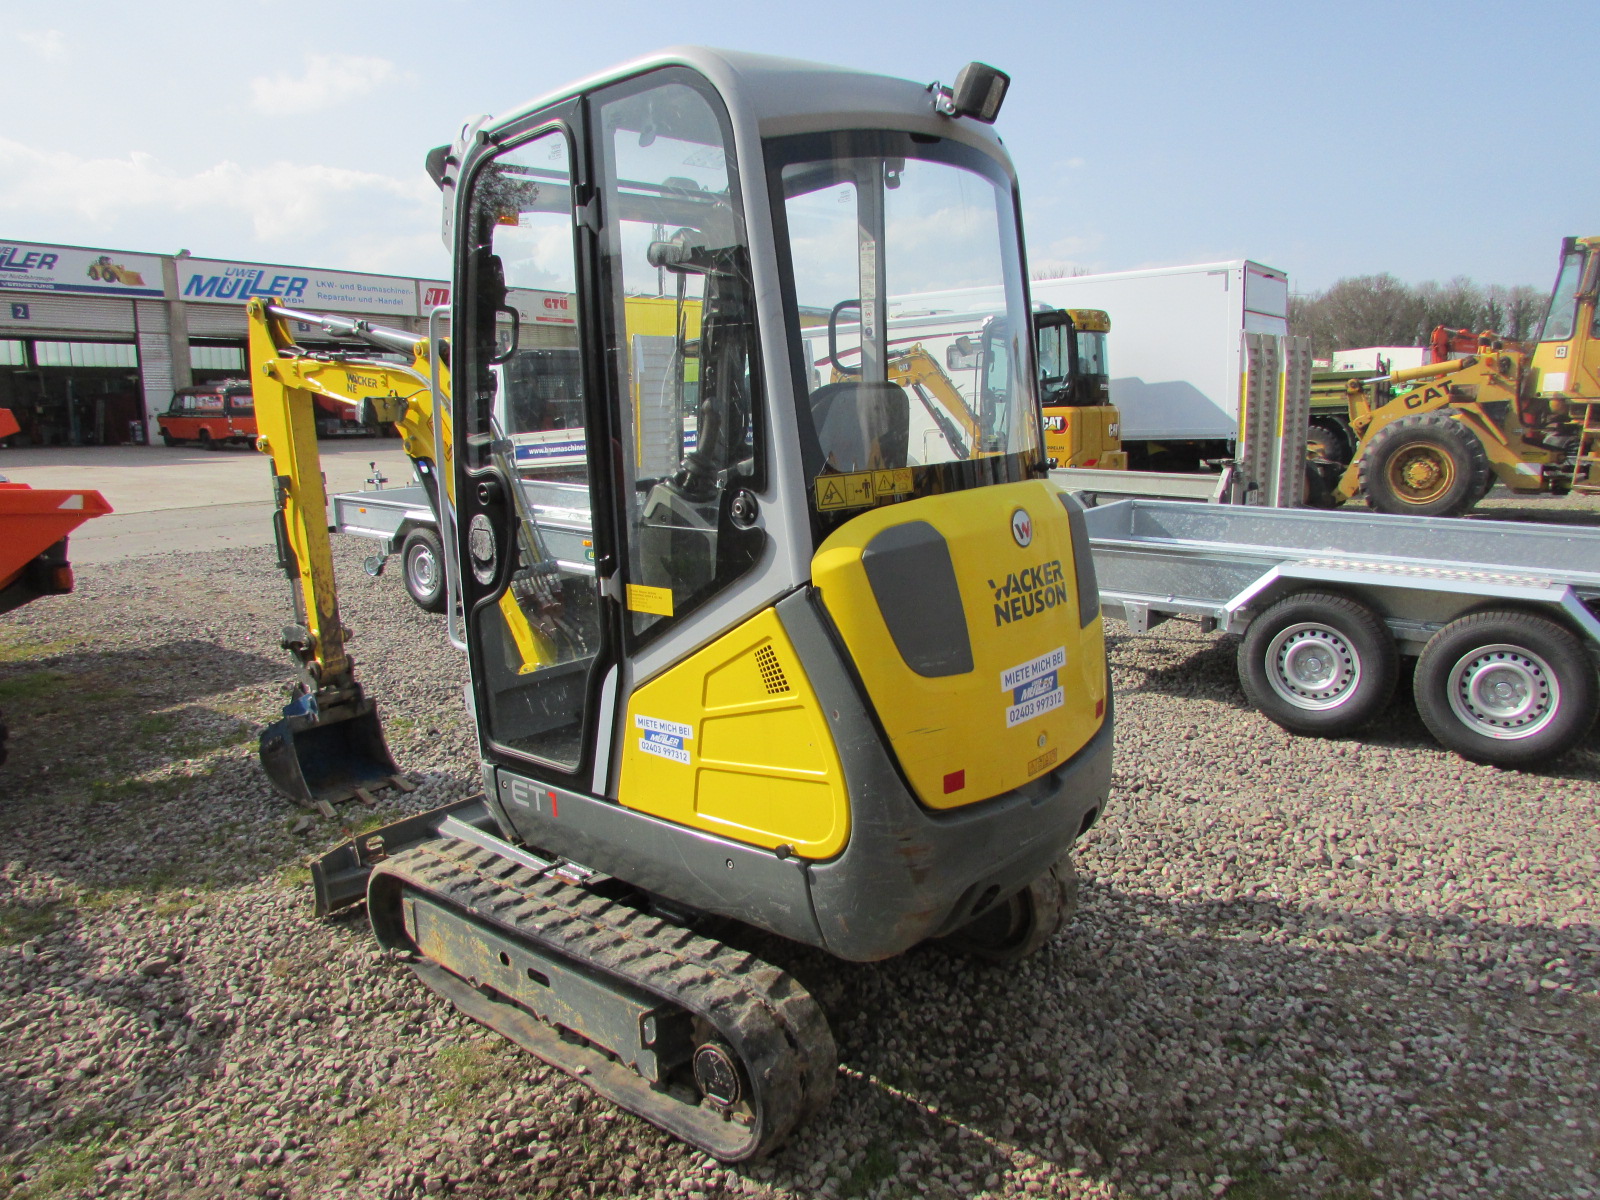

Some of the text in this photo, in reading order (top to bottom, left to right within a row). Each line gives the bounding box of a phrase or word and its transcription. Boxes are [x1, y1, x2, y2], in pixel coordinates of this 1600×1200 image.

[225, 267, 257, 278] UWE
[317, 292, 356, 302] Reparatur
[543, 297, 569, 310] GTÜ
[16, 306, 26, 318] 2
[346, 372, 378, 388] WACKER
[1403, 379, 1453, 410] CAT
[1043, 416, 1063, 431] CAT
[987, 559, 1064, 601] WACKER
[994, 581, 1067, 628] NEUSON
[1004, 650, 1064, 687] MIETE MICH BEI
[1009, 691, 1062, 723] 02403 997312
[637, 718, 658, 730] MIETE
[659, 722, 677, 733] MICH
[678, 726, 690, 736] BEI
[641, 741, 688, 762] 02403 997312
[511, 780, 559, 818] ET1
